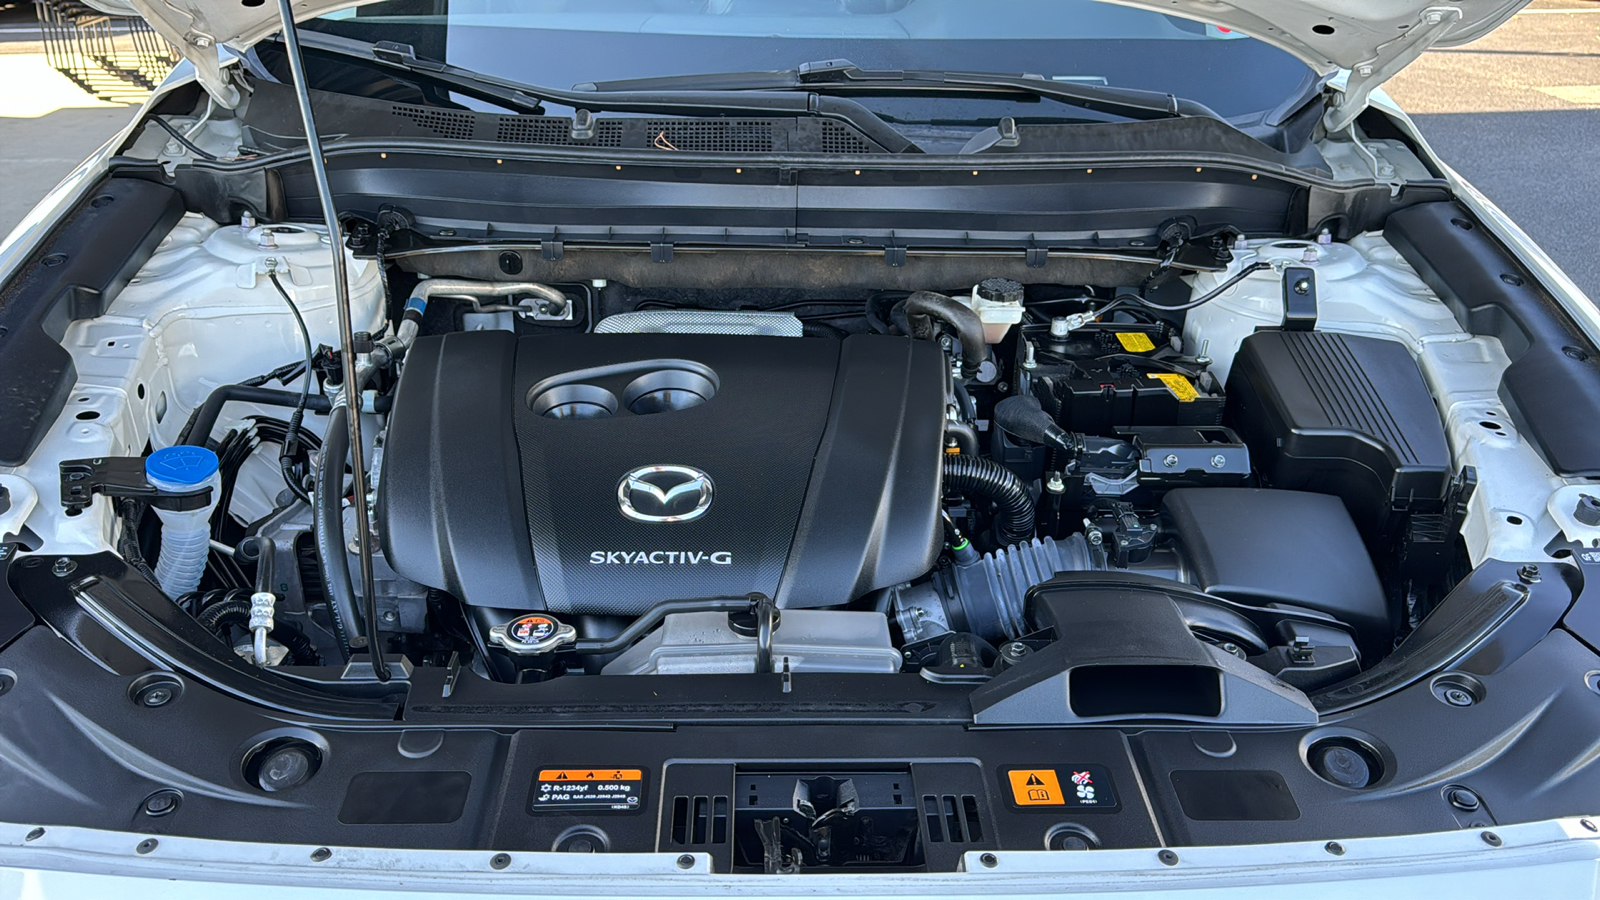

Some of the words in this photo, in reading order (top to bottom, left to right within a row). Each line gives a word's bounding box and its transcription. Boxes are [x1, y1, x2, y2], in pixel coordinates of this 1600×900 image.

[590, 551, 732, 565] SKYACTIV-G
[331, 600, 343, 629] GALAXY
[553, 784, 589, 792] R-1234yf
